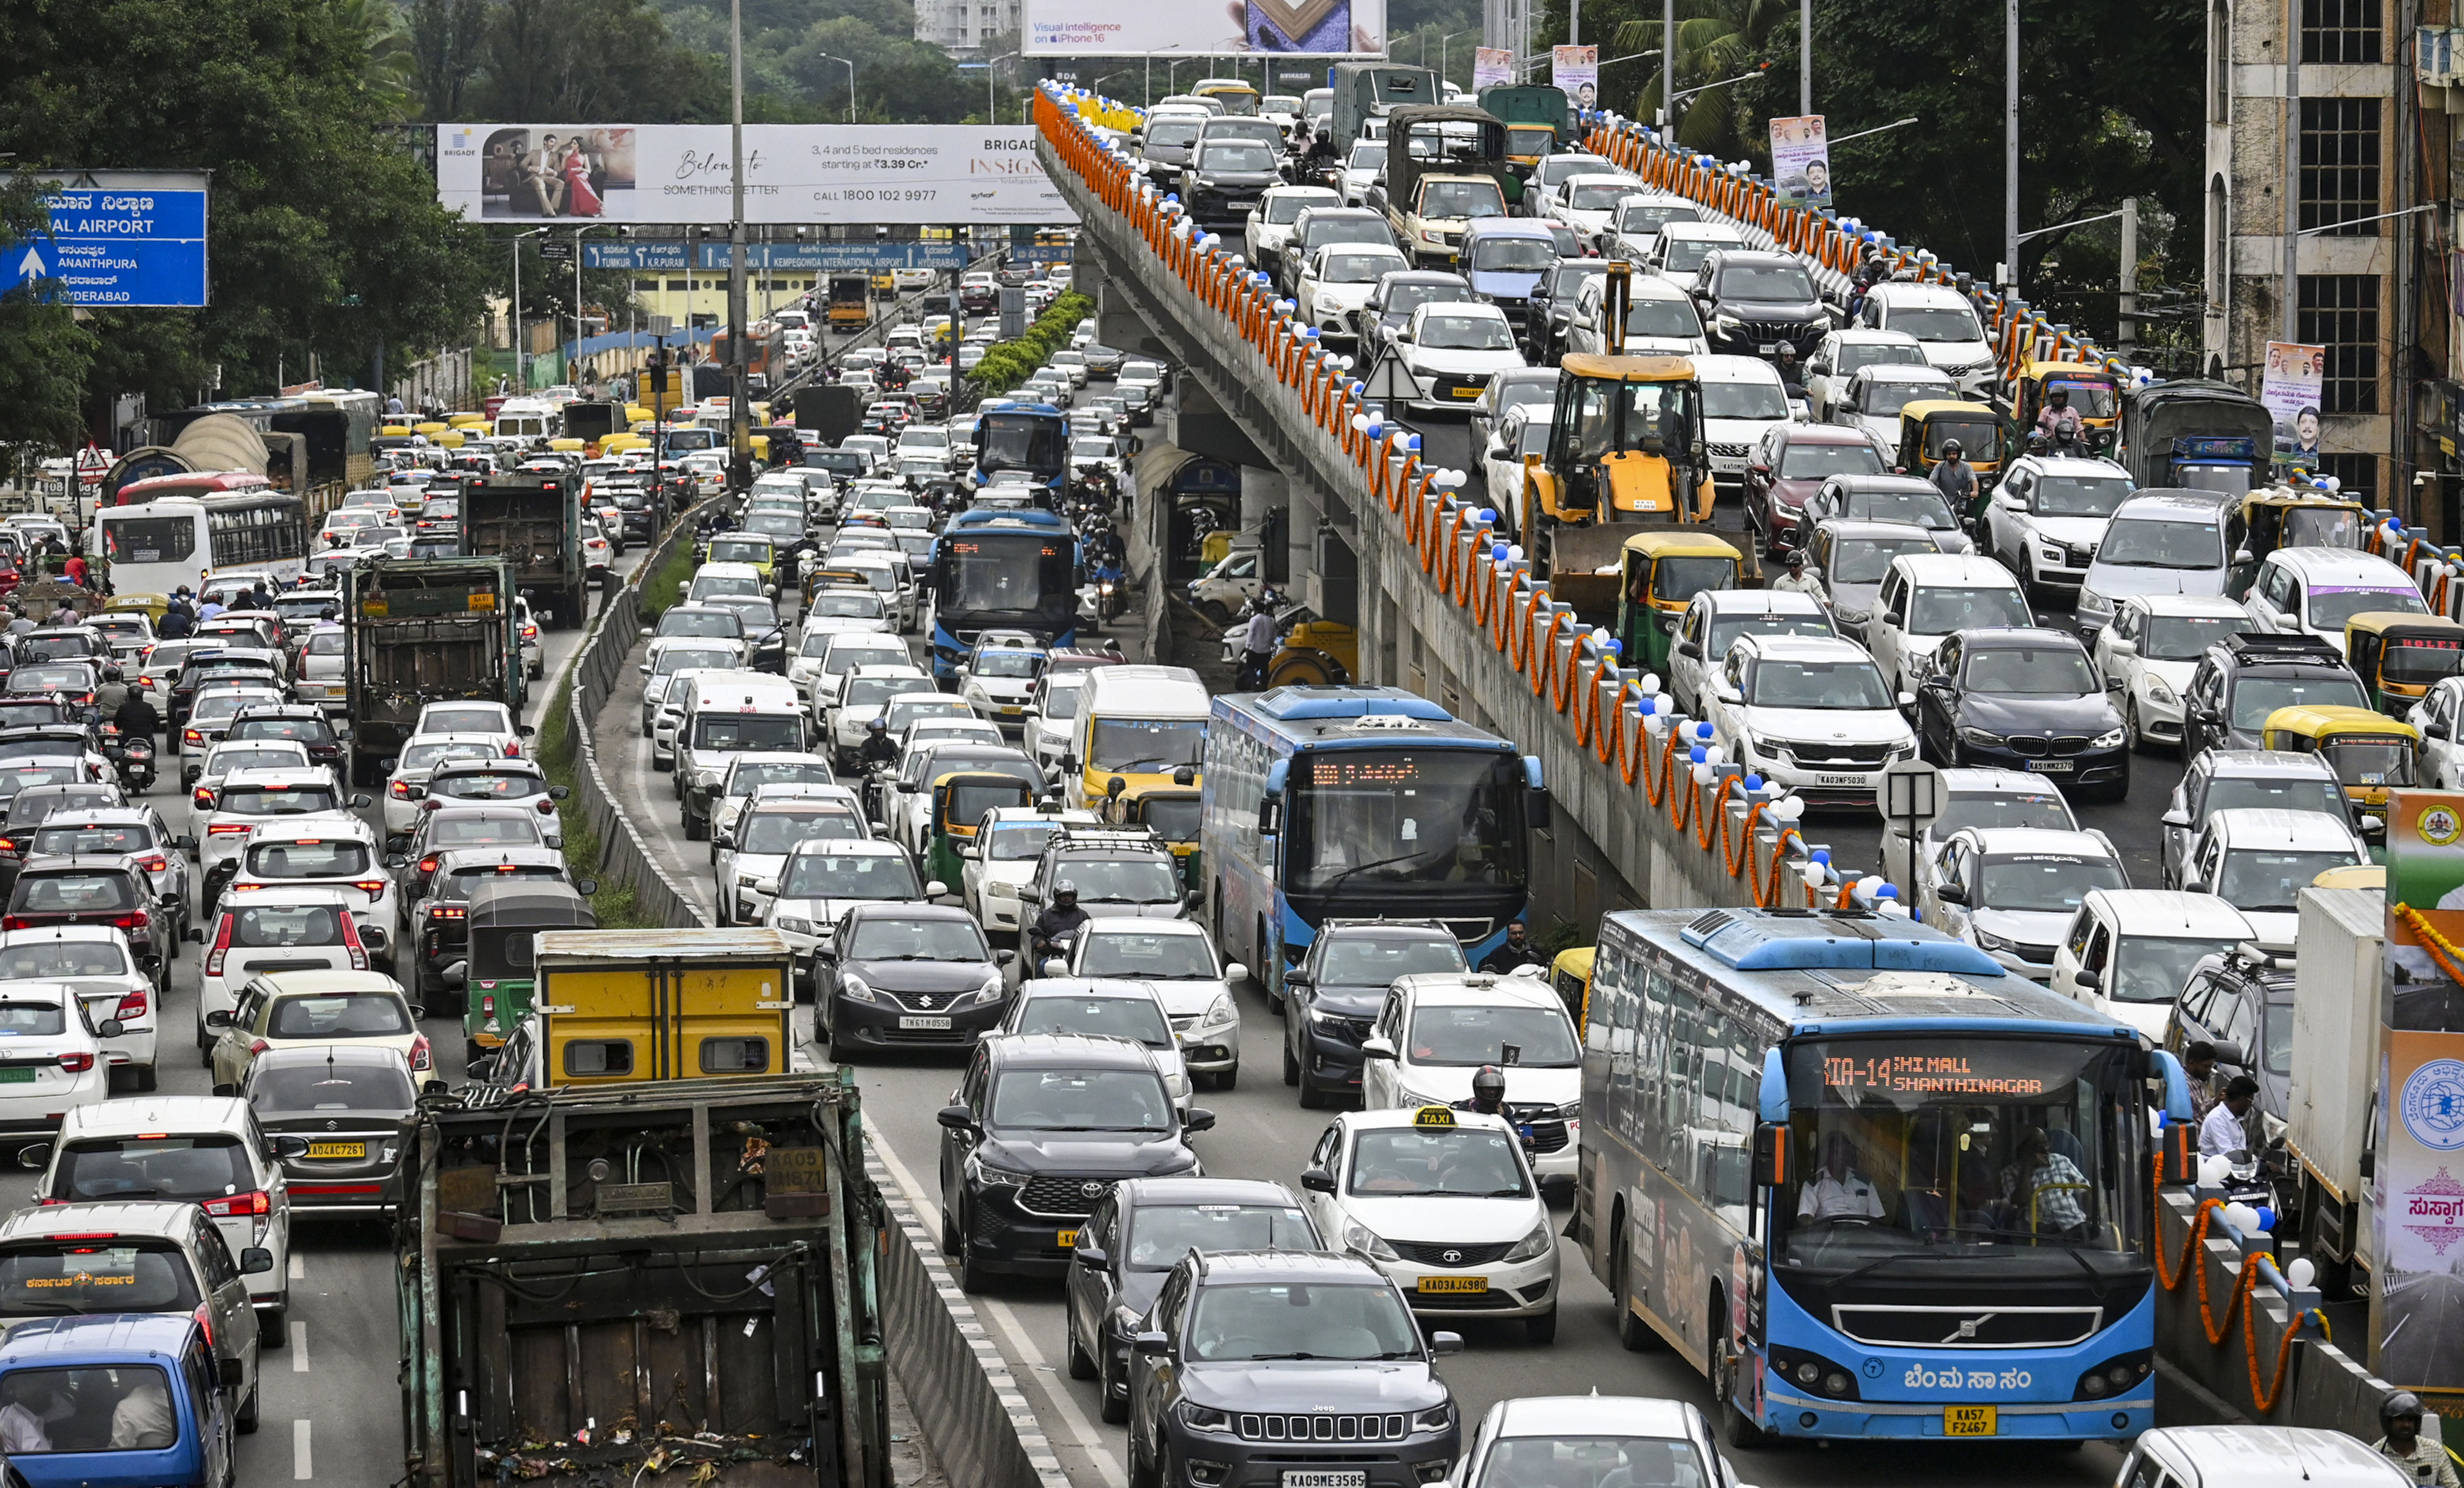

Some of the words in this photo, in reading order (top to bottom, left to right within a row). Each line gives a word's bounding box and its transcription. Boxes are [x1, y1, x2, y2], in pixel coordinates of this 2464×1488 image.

[1034, 23, 1063, 32] Visual
[1065, 22, 1121, 33] Intelligence
[1035, 35, 1048, 43] on
[1058, 33, 1093, 43] iPhone
[1095, 33, 1105, 43] 16
[1056, 72, 1077, 80] BDA
[984, 139, 1037, 150] BRIGAD
[812, 146, 821, 157] 3,
[823, 145, 830, 154] 4
[832, 145, 851, 155] and
[853, 145, 861, 154] 5
[862, 145, 882, 155] bed
[883, 145, 938, 155] residences
[675, 149, 734, 181] Belon
[821, 160, 860, 171] starting
[862, 160, 872, 169] at
[874, 159, 906, 169] ₹3.39
[970, 158, 1044, 174] INSIGN
[664, 185, 732, 195] SOMETHING
[742, 186, 779, 195] ETTER
[814, 192, 840, 201] CALL
[843, 190, 875, 201] 1800
[878, 190, 901, 201] 102
[904, 190, 937, 201] 9977
[46, 193, 93, 211] ಮಾನ
[50, 219, 74, 234] AL
[78, 220, 154, 235] AIRPORT
[57, 245, 106, 257] ಅನಂತಪುರ
[57, 258, 138, 269] ANANTHPURA
[601, 258, 631, 267] TUMKUR
[647, 258, 685, 267] K.R.PURAM
[717, 258, 759, 268] YELNKA
[773, 258, 822, 268] KEMPEGOWDA
[822, 258, 873, 268] INTERNATIONAL
[873, 258, 904, 268] AIRPORT
[917, 258, 960, 268] HYDERABAD
[2402, 638, 2458, 650] ROLEX
[739, 705, 757, 714] SISA
[1927, 1056, 1971, 1074] MALL
[2432, 1065, 2464, 1082] ಅಭಿವೃ
[1893, 1077, 2042, 1093] SHANTHINAGAR
[1422, 1114, 1450, 1124] TAXI
[771, 1151, 817, 1168] KA05
[2409, 1196, 2464, 1225] ಸುಸ್ವಾಗ
[26, 1277, 73, 1288] ಕರ್ನಾಟಕ
[94, 1274, 135, 1286] ಸರ್ಕಾರ
[1425, 1280, 1485, 1291] KA03AJ4980
[1311, 1404, 1335, 1412] Jeep
[1957, 1409, 1984, 1421] KA57
[1952, 1421, 1987, 1433] F2467
[1290, 1475, 1365, 1487] KA09ME3585
